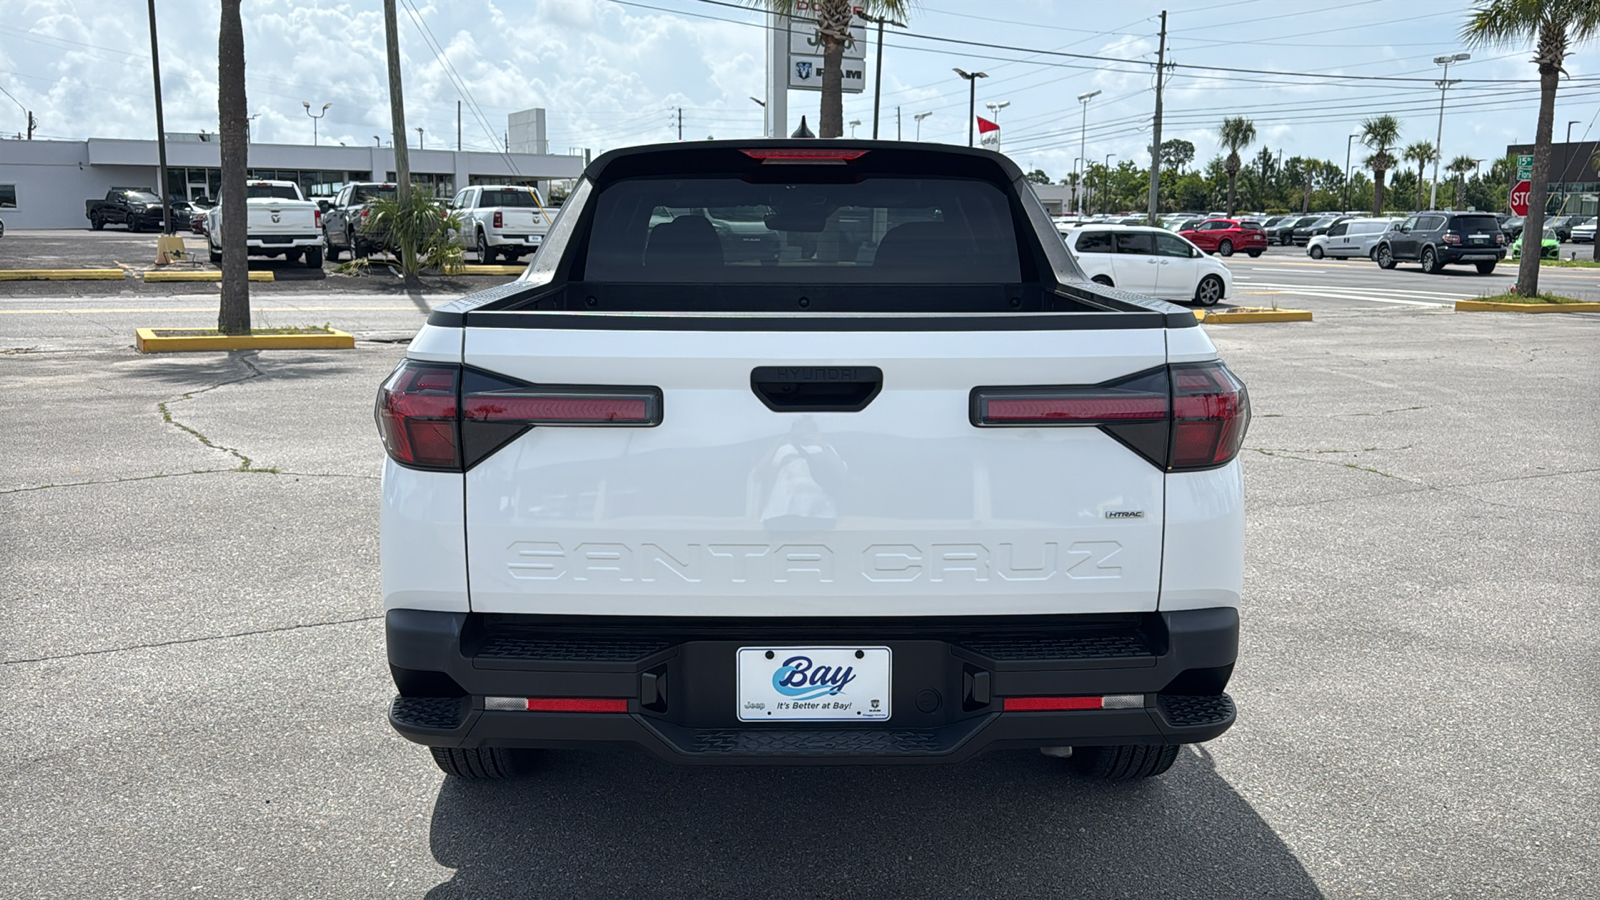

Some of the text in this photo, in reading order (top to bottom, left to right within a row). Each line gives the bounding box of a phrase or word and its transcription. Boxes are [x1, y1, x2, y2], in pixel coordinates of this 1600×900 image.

[816, 67, 862, 79] RM
[777, 369, 857, 380] HYUNDAI
[506, 541, 1123, 582] SANTA CRUZ
[779, 656, 856, 695] Bay
[744, 701, 765, 710] Jeep
[833, 702, 852, 710] Bay!
